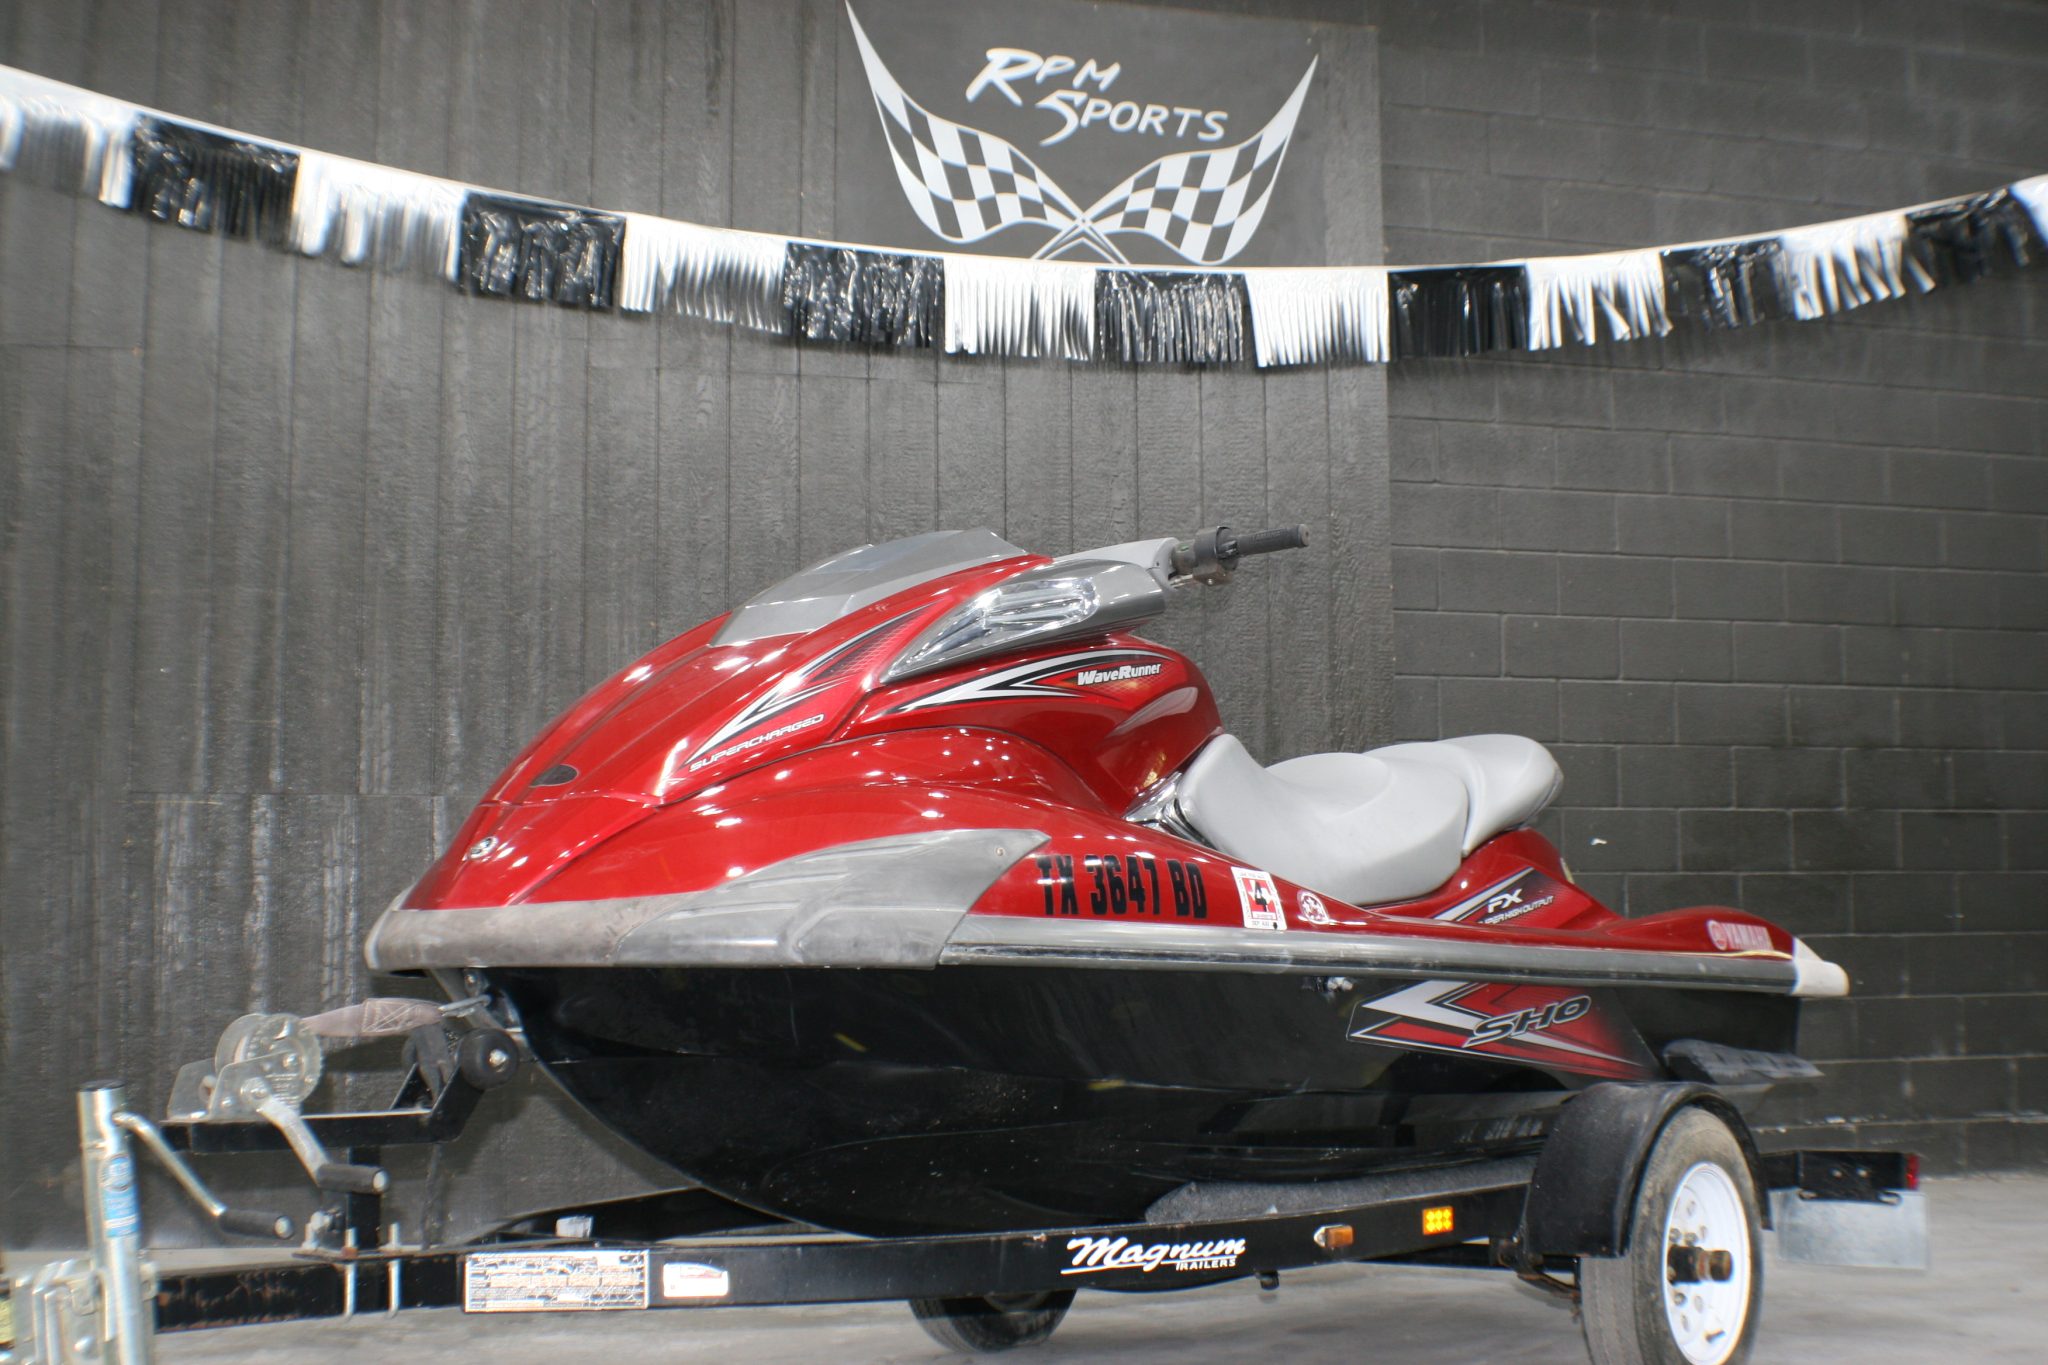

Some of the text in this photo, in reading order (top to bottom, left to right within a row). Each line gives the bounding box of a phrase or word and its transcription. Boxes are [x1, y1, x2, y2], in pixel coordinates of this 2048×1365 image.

[966, 47, 1121, 107] RPM
[1034, 89, 1229, 147] SPORTS
[1077, 663, 1162, 686] WaveRunner
[688, 713, 825, 773] SUPERCHARGED
[1036, 853, 1080, 916] TX
[1084, 853, 1161, 916] 3647
[1487, 888, 1523, 914] FX
[1461, 995, 1593, 1049] SHO
[1066, 1236, 1247, 1272] Magnum
[1175, 1257, 1237, 1272] TRAILERS
